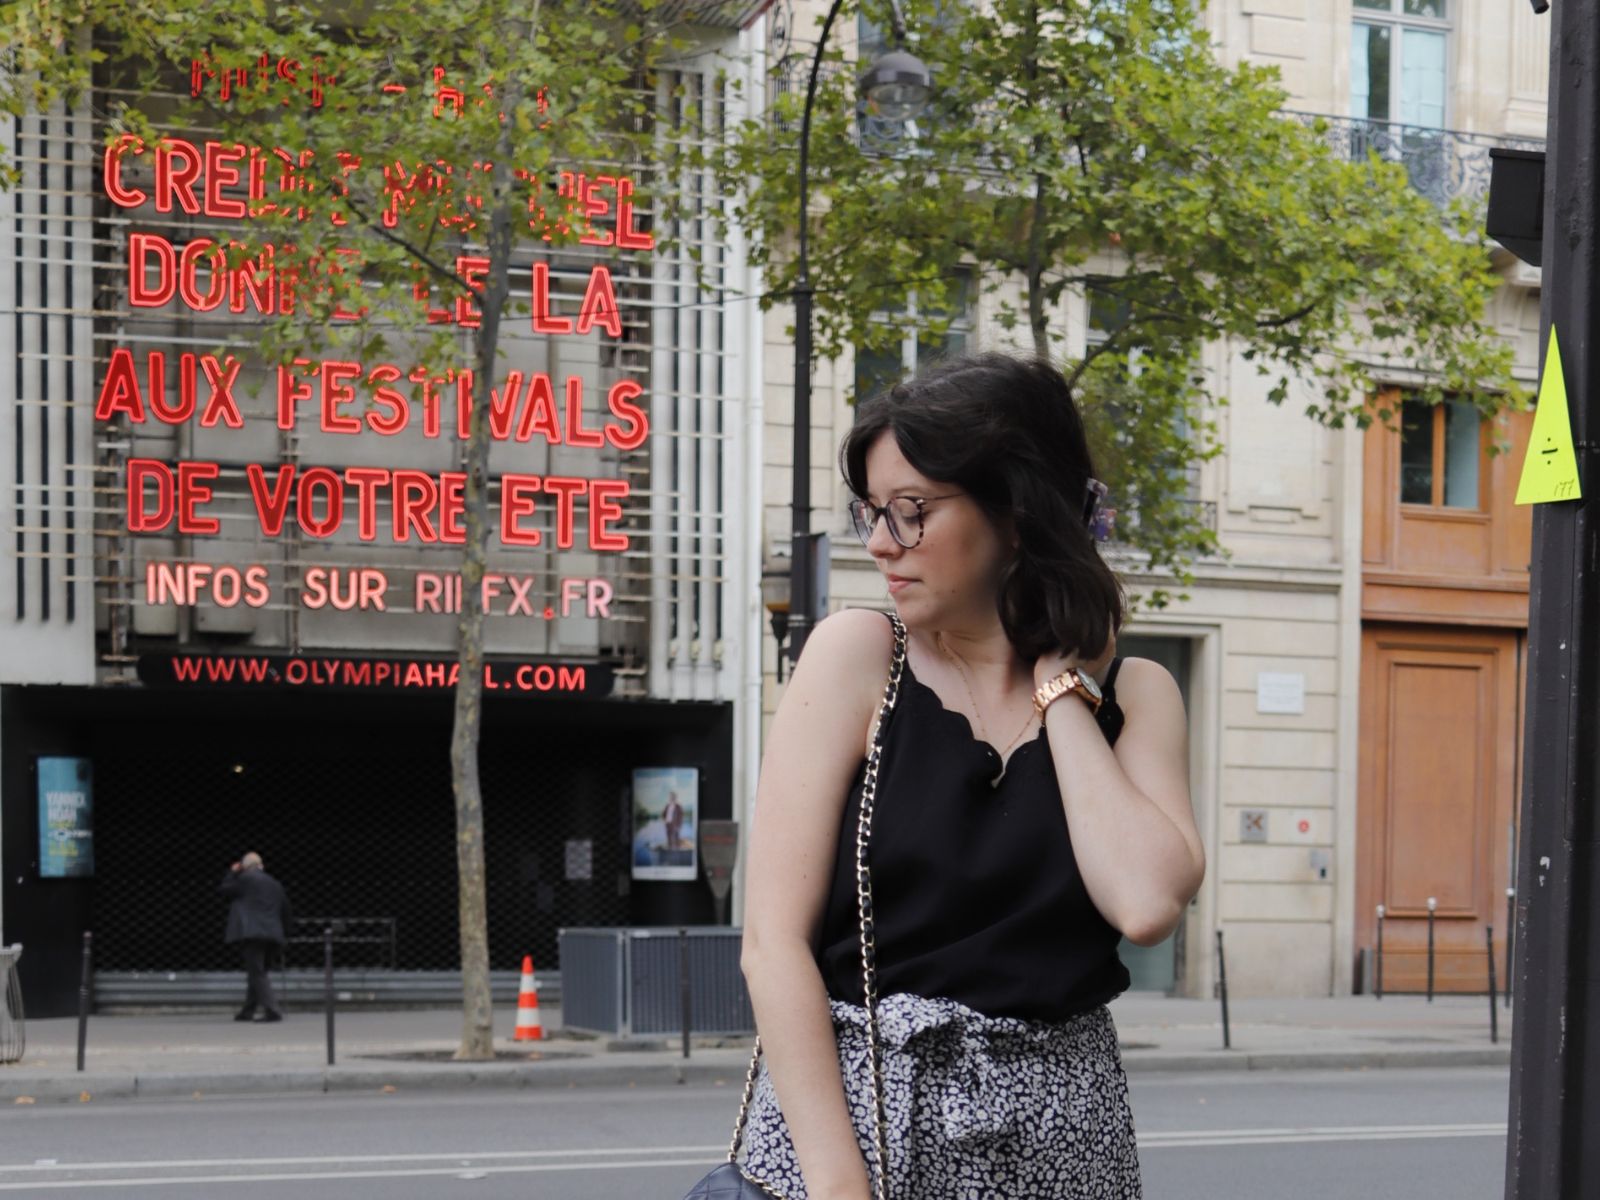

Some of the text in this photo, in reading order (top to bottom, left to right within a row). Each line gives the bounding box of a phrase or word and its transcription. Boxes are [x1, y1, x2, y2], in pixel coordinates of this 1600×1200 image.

[531, 260, 622, 338] LA
[94, 346, 650, 450] AUX FESTIVALS
[126, 457, 630, 551] DE VOTRE ETE
[146, 562, 271, 608] INFOS
[302, 566, 388, 612] SUR
[171, 655, 586, 692] WWW.OLYMPIAHAL.COM
